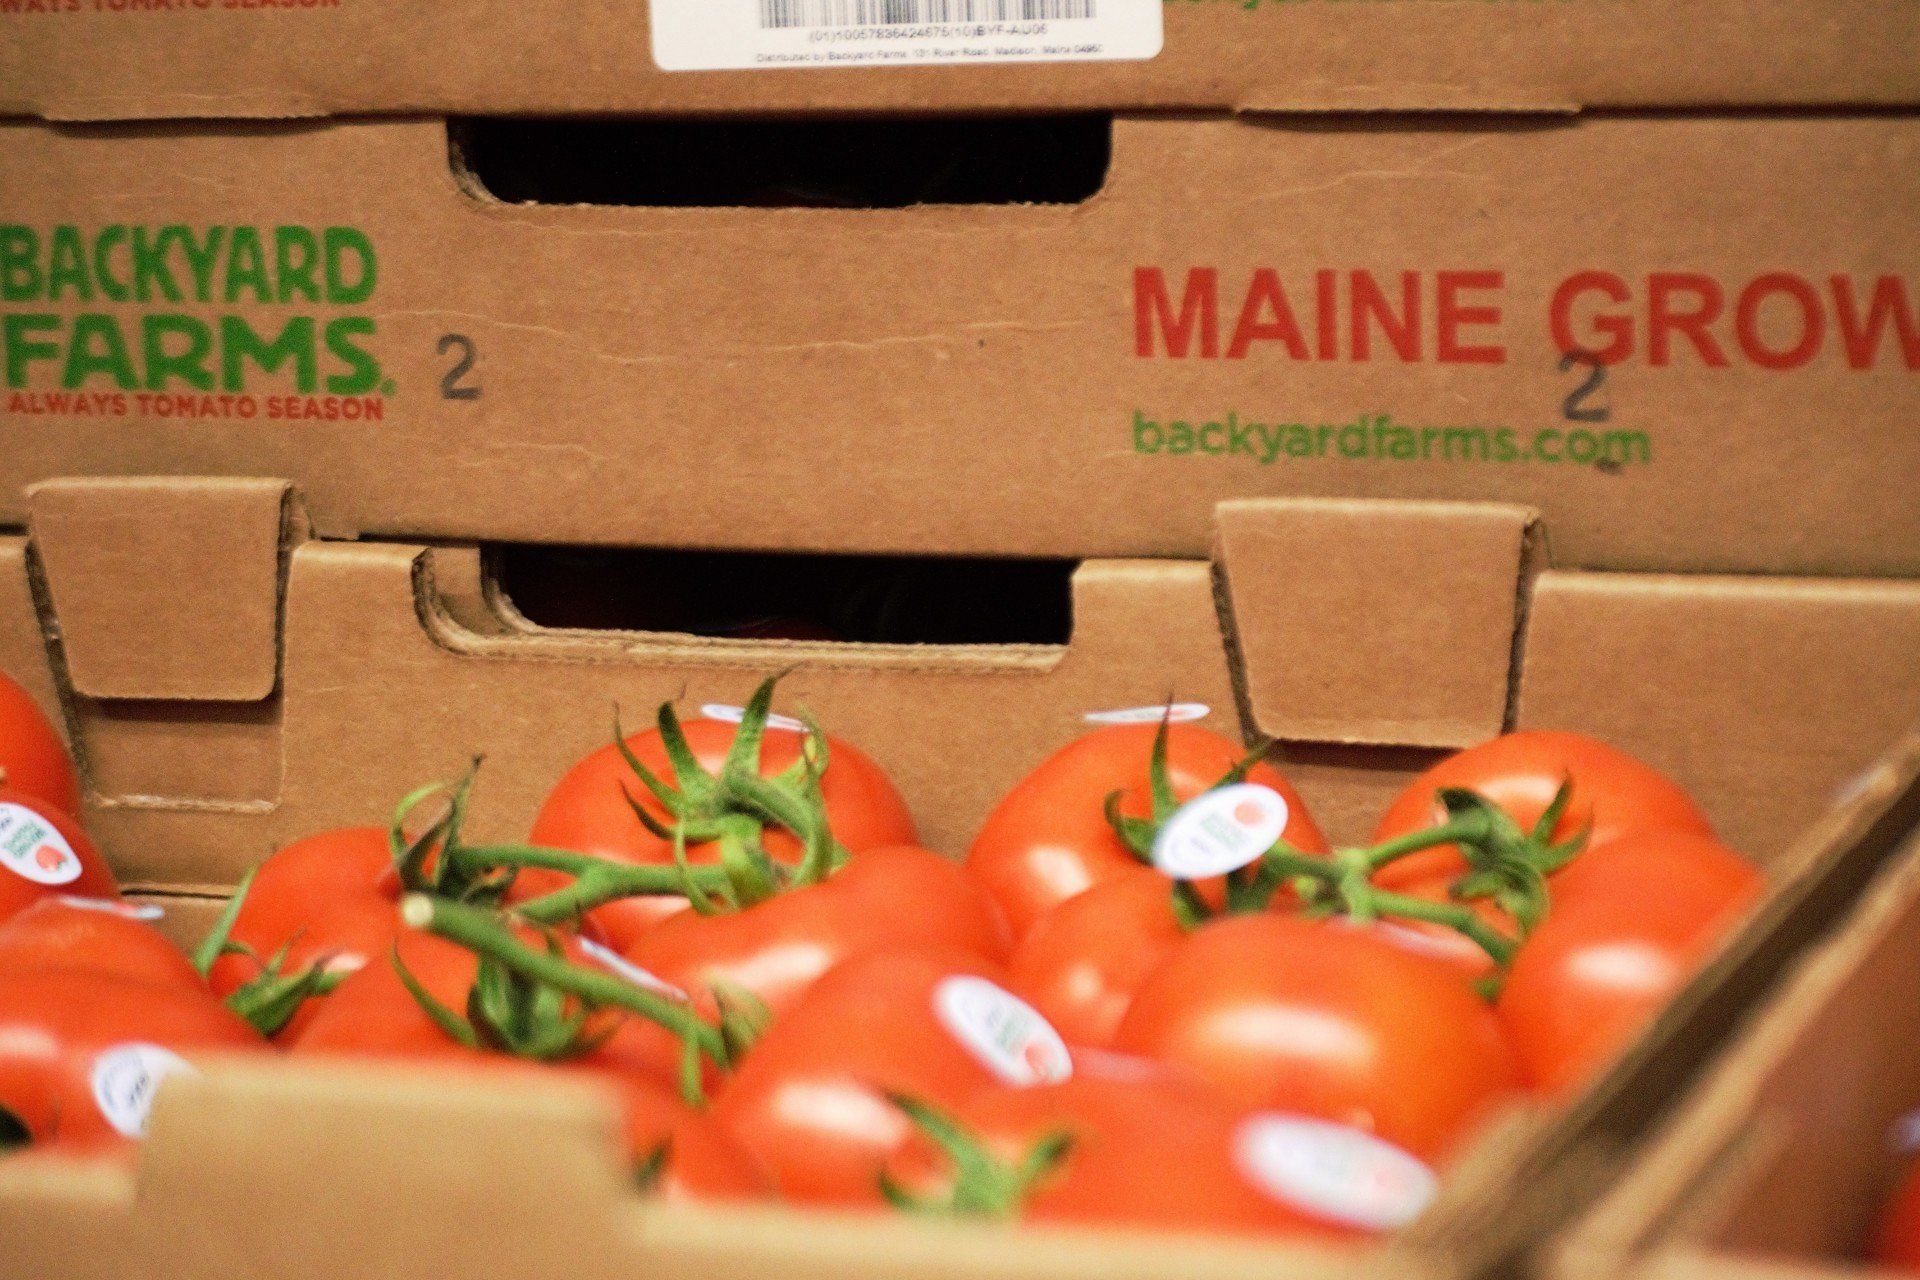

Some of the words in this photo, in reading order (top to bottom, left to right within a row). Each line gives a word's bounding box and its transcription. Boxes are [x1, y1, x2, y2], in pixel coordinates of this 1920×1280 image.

[0, 224, 378, 304] BACKYARD
[2, 313, 383, 396] FARMS
[1132, 266, 1507, 364] MAINE
[1548, 269, 1920, 371] GROW
[436, 333, 482, 400] 2
[1557, 348, 1611, 422] 2
[8, 393, 128, 416] ALWAYS
[137, 394, 258, 419] TOMATO
[267, 396, 384, 421] SEASON
[1131, 411, 1652, 464] backyardfarms.com
